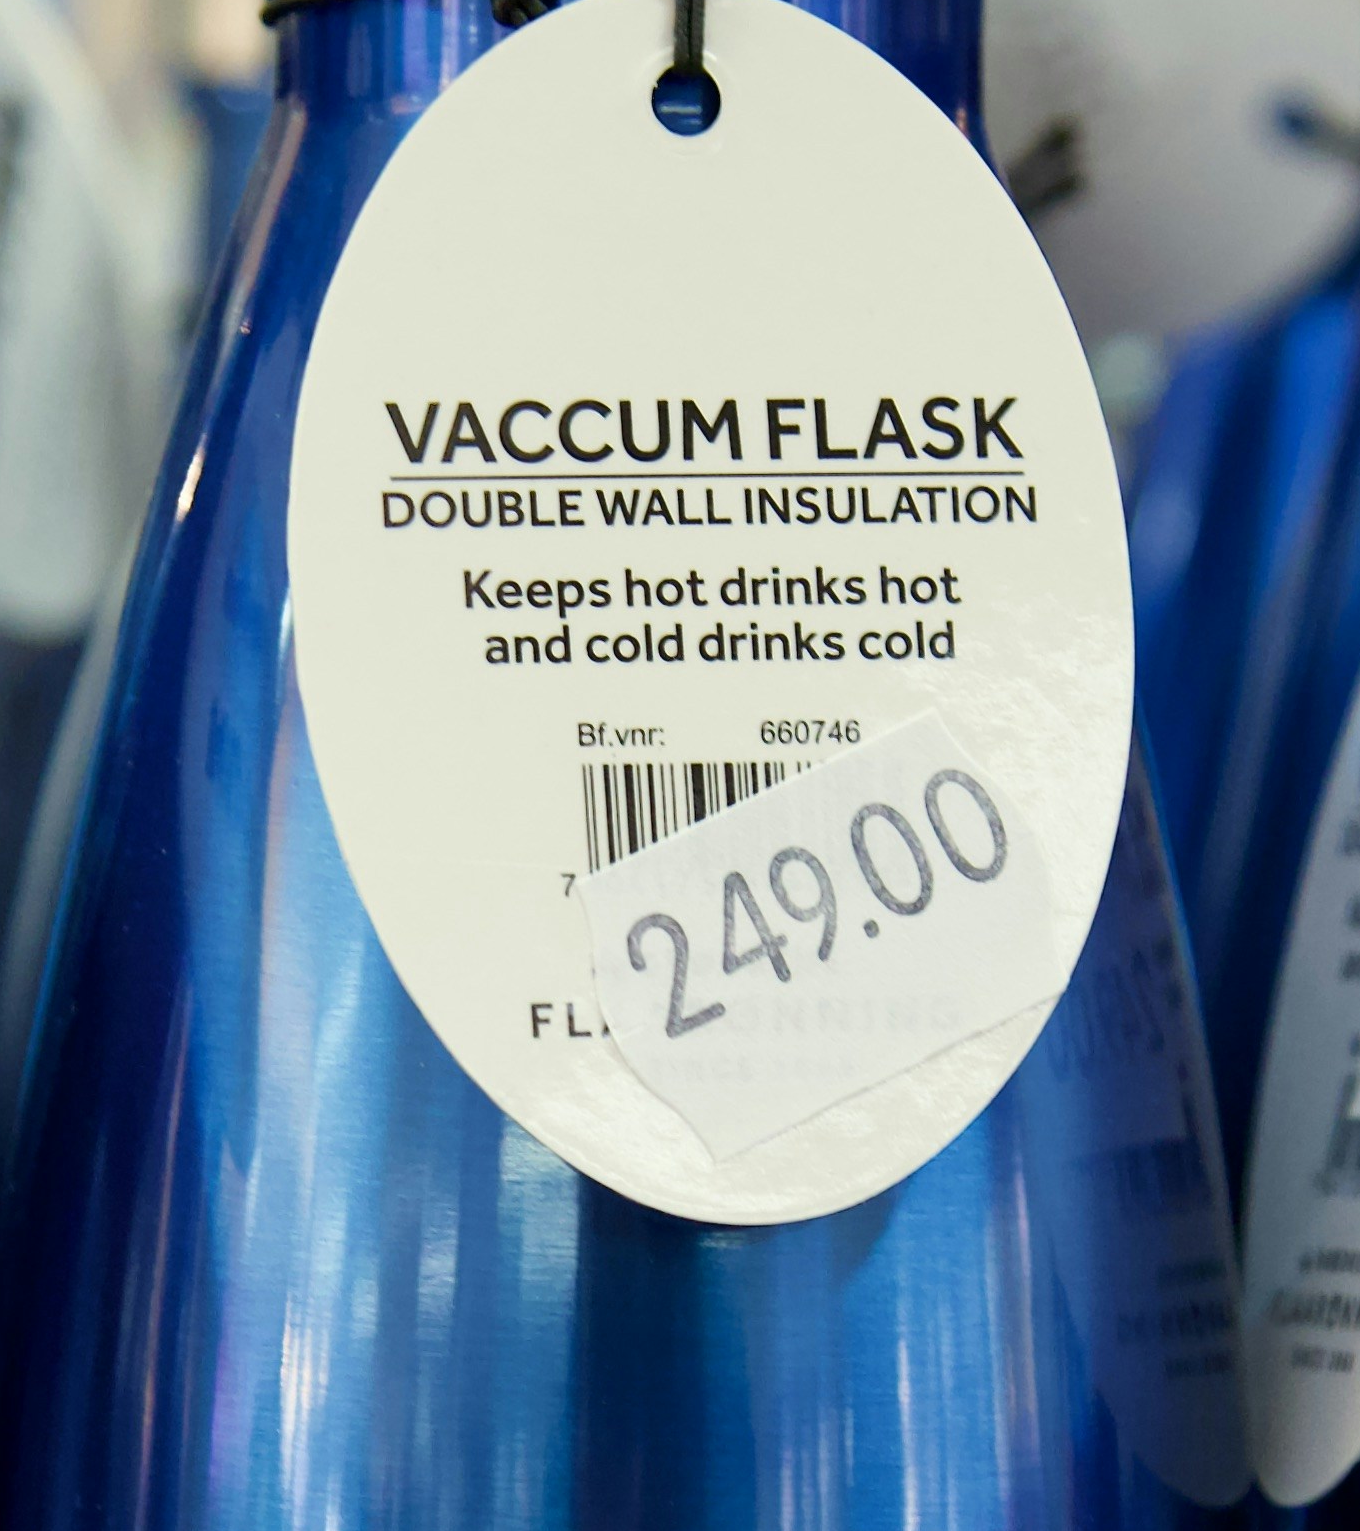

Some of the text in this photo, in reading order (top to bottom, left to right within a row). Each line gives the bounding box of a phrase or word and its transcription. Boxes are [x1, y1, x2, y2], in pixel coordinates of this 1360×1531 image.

[386, 397, 1023, 463] VACCUM FLASK
[383, 486, 1036, 528] DOUBLE WALL INSULATION
[464, 566, 961, 618] Keeps hot drinks hot
[486, 621, 954, 663] and cold drinks cold
[578, 720, 860, 747] Bf.vnr: 660746
[625, 768, 1007, 1038] 249.00
